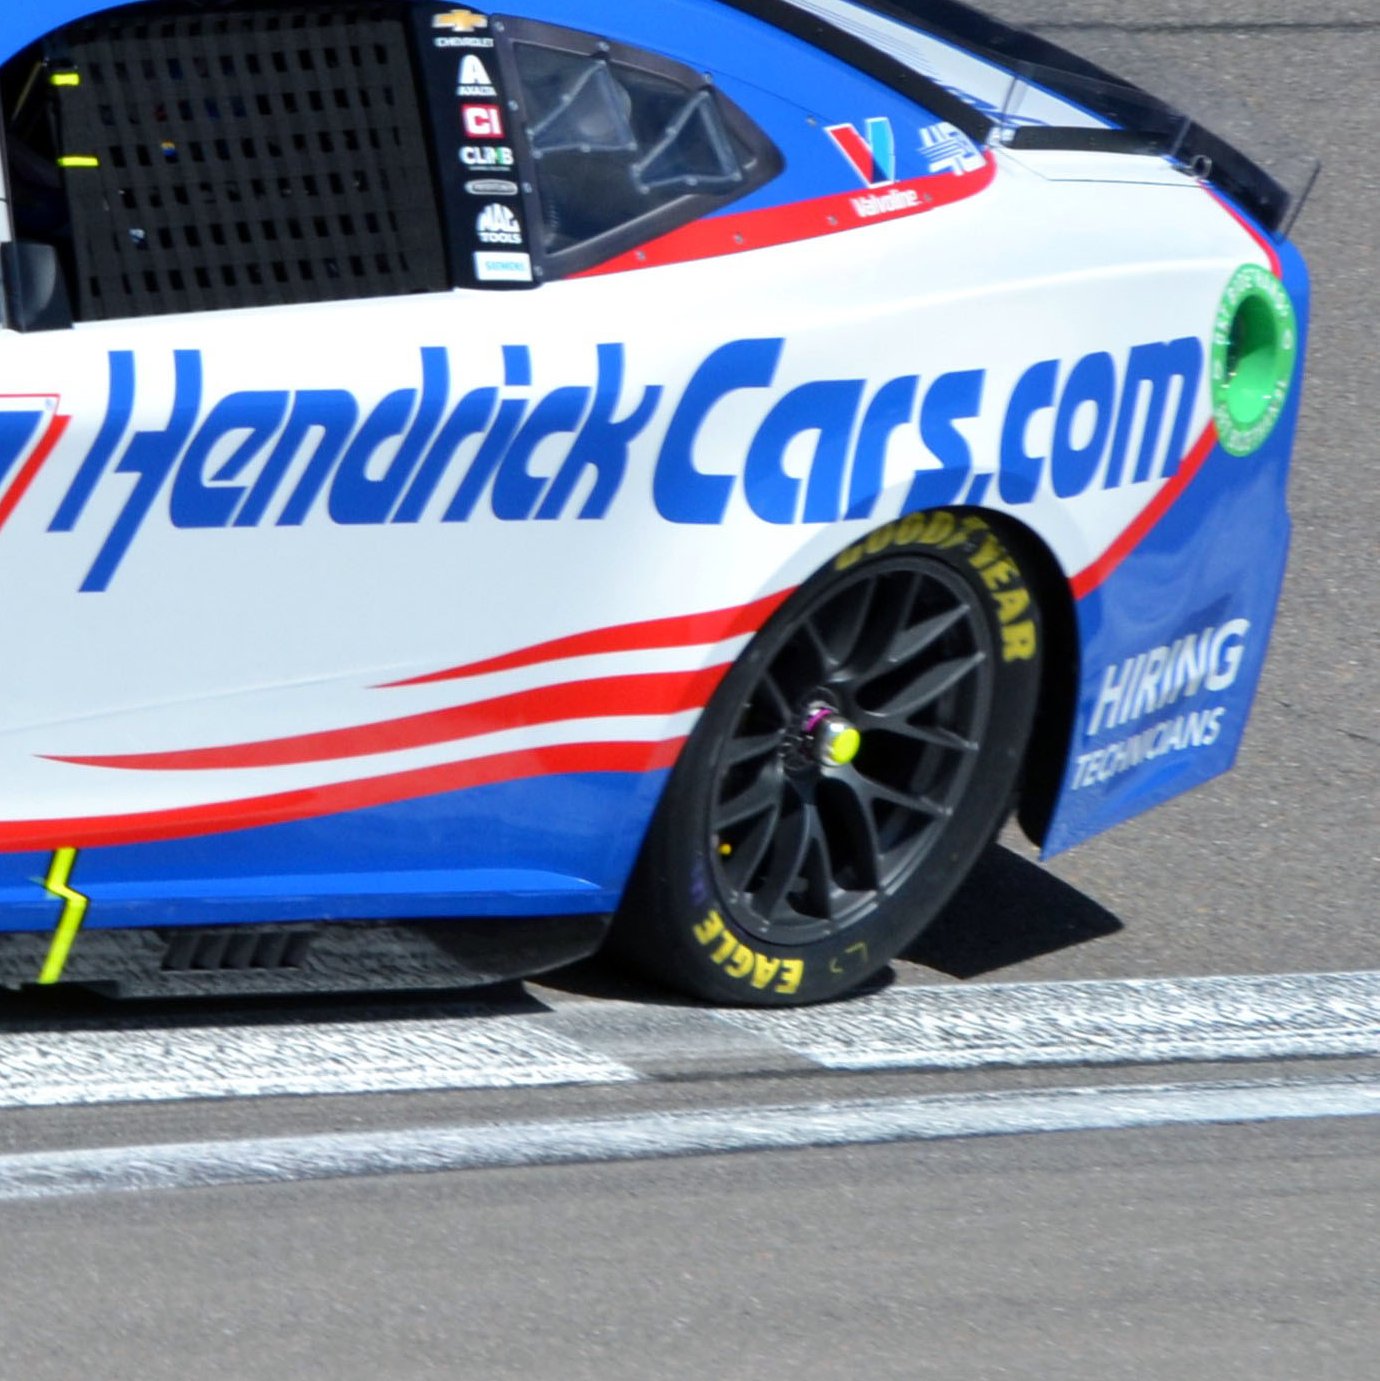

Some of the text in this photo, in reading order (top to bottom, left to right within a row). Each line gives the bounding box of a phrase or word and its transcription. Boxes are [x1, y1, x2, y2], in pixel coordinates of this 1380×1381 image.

[849, 188, 921, 218] Valvoline
[1086, 618, 1251, 736] HIRING
[1070, 706, 1227, 791] TECHNICIANS
[692, 909, 805, 995] EAGLE
